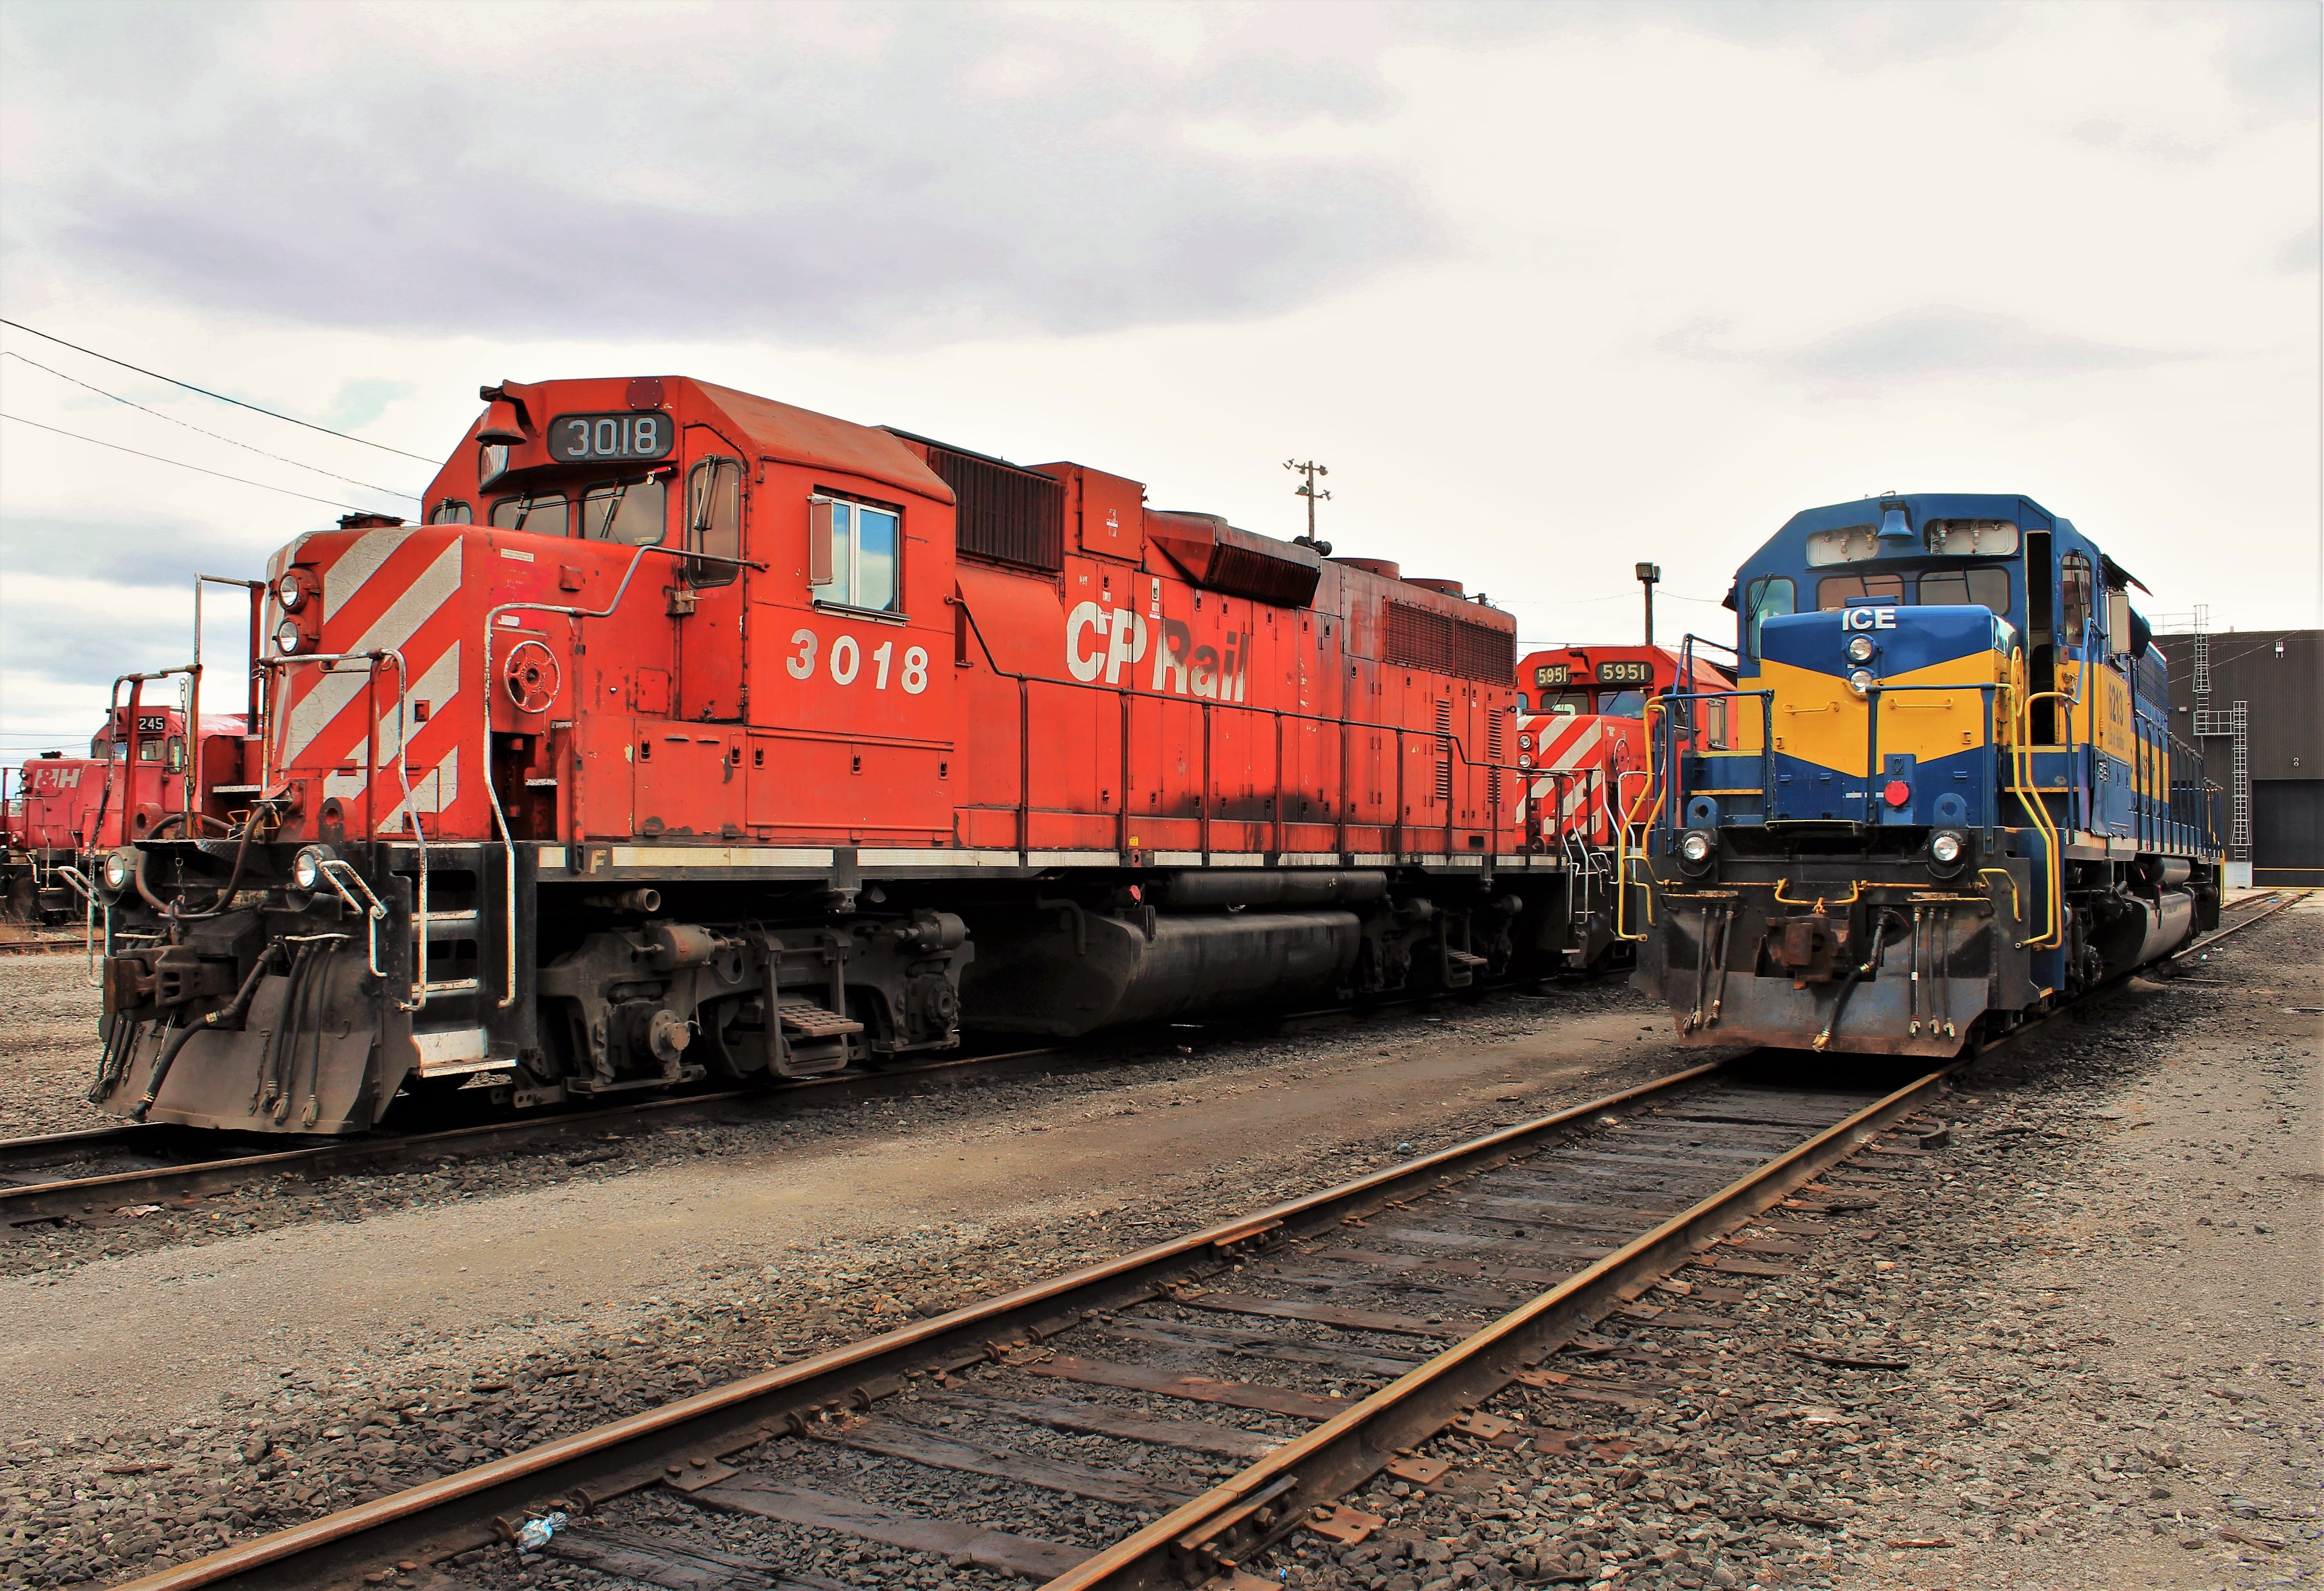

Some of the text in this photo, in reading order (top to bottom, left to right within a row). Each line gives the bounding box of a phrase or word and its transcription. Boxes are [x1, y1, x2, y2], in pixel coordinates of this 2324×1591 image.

[567, 417, 657, 456] 3018
[1842, 608, 1897, 630] ICE
[786, 629, 928, 694] 3018
[1067, 601, 1250, 703] CP Rail
[1538, 666, 1567, 684] 5951
[1603, 664, 1645, 680] 5951
[2108, 682, 2123, 726] 6213
[590, 850, 608, 875] F
